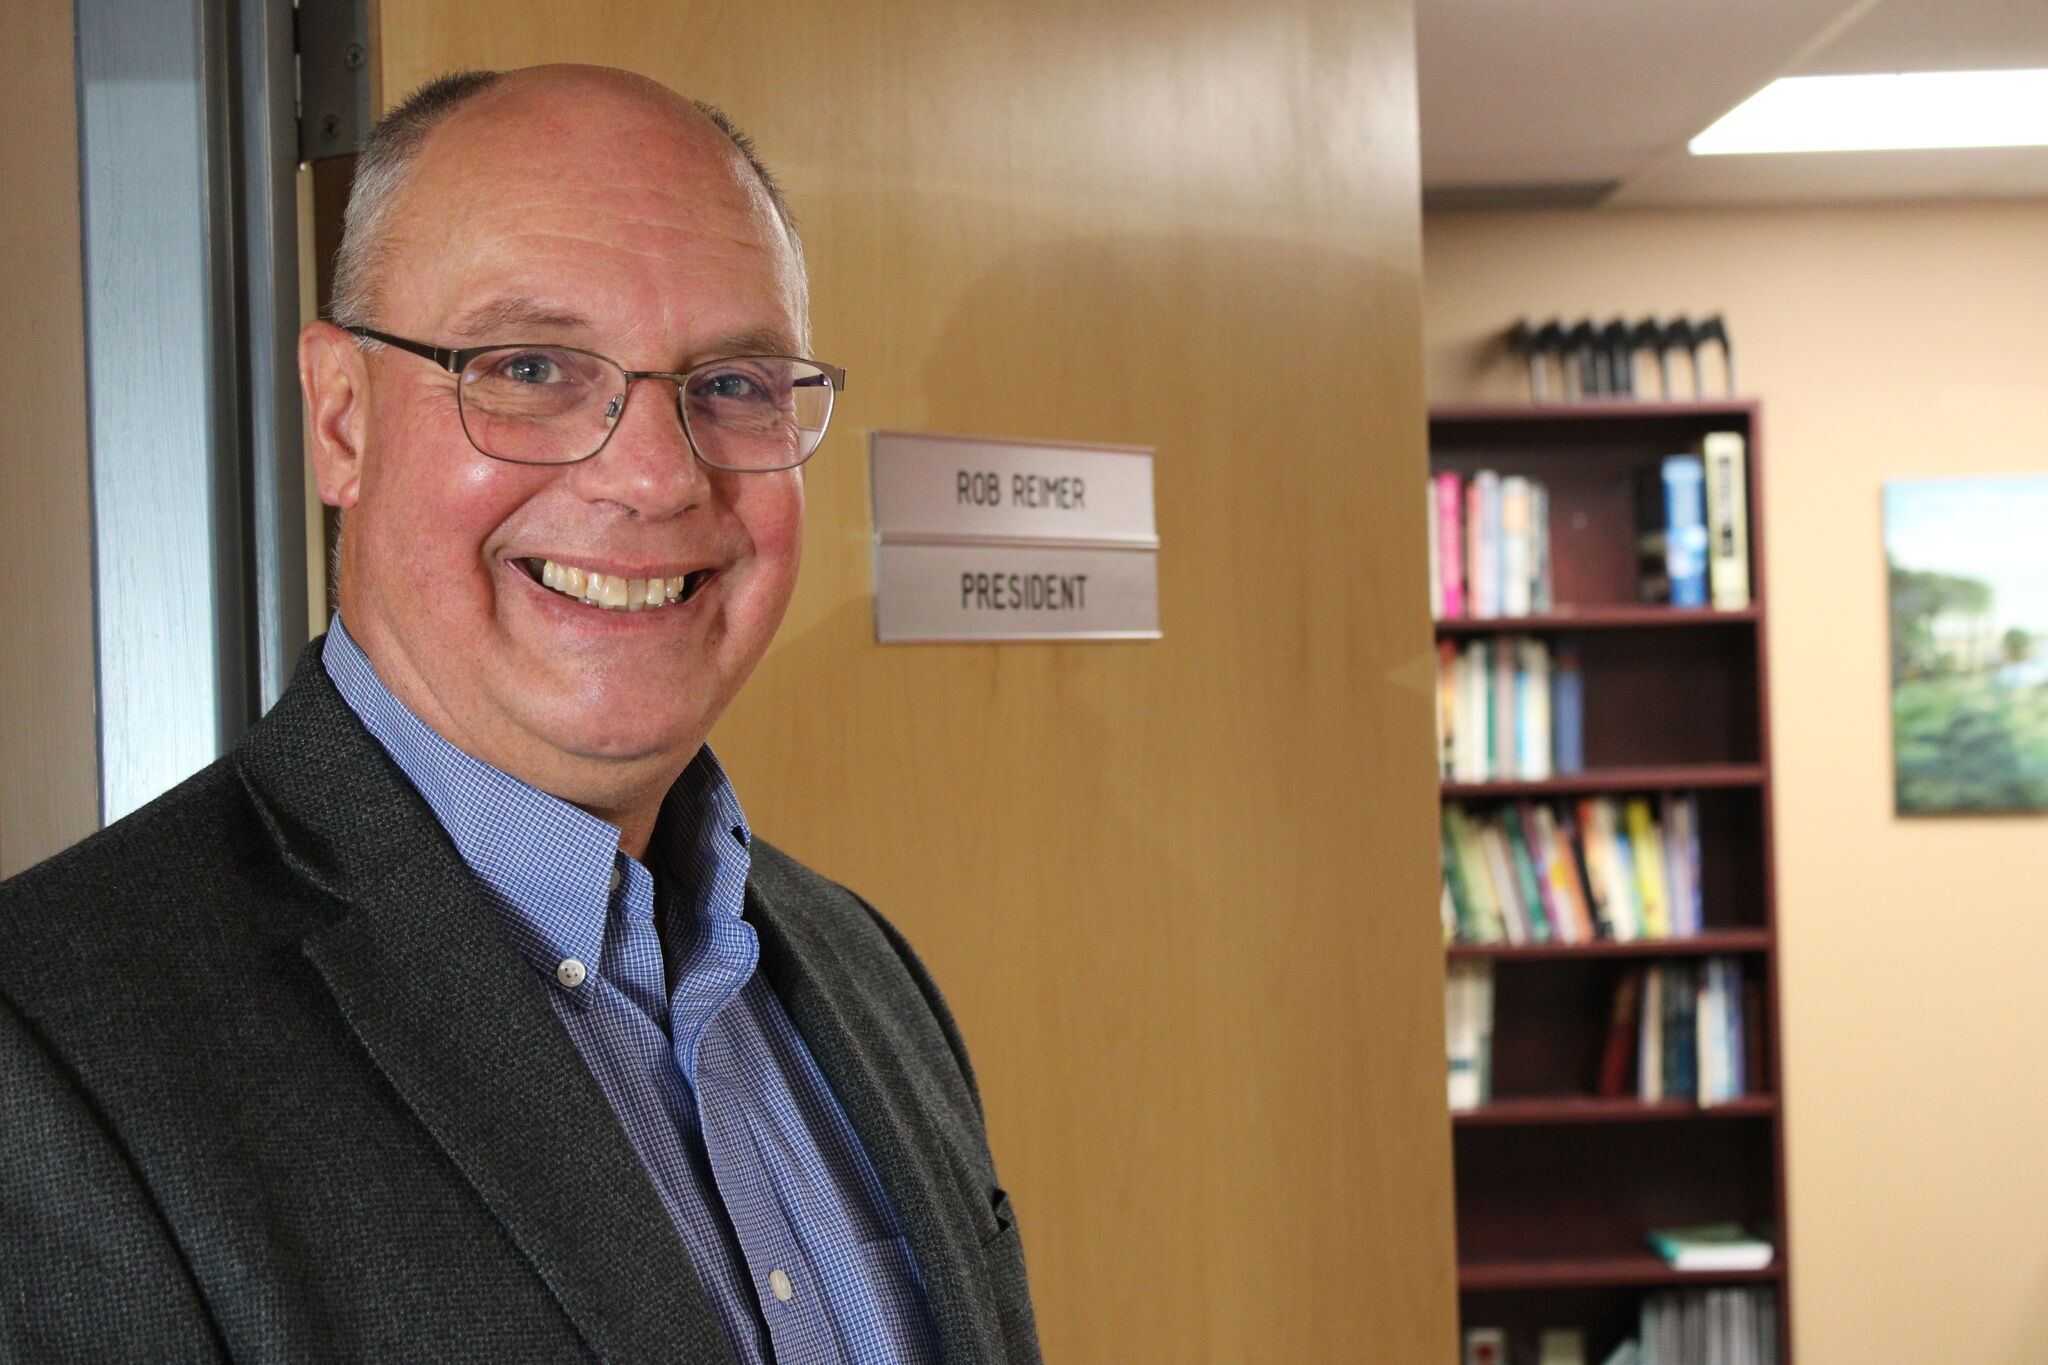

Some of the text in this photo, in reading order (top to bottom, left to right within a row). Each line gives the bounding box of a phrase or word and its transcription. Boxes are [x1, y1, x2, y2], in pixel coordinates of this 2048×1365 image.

[957, 470, 1086, 509] ROB REIMER
[961, 572, 1087, 610] PRESIDENT
